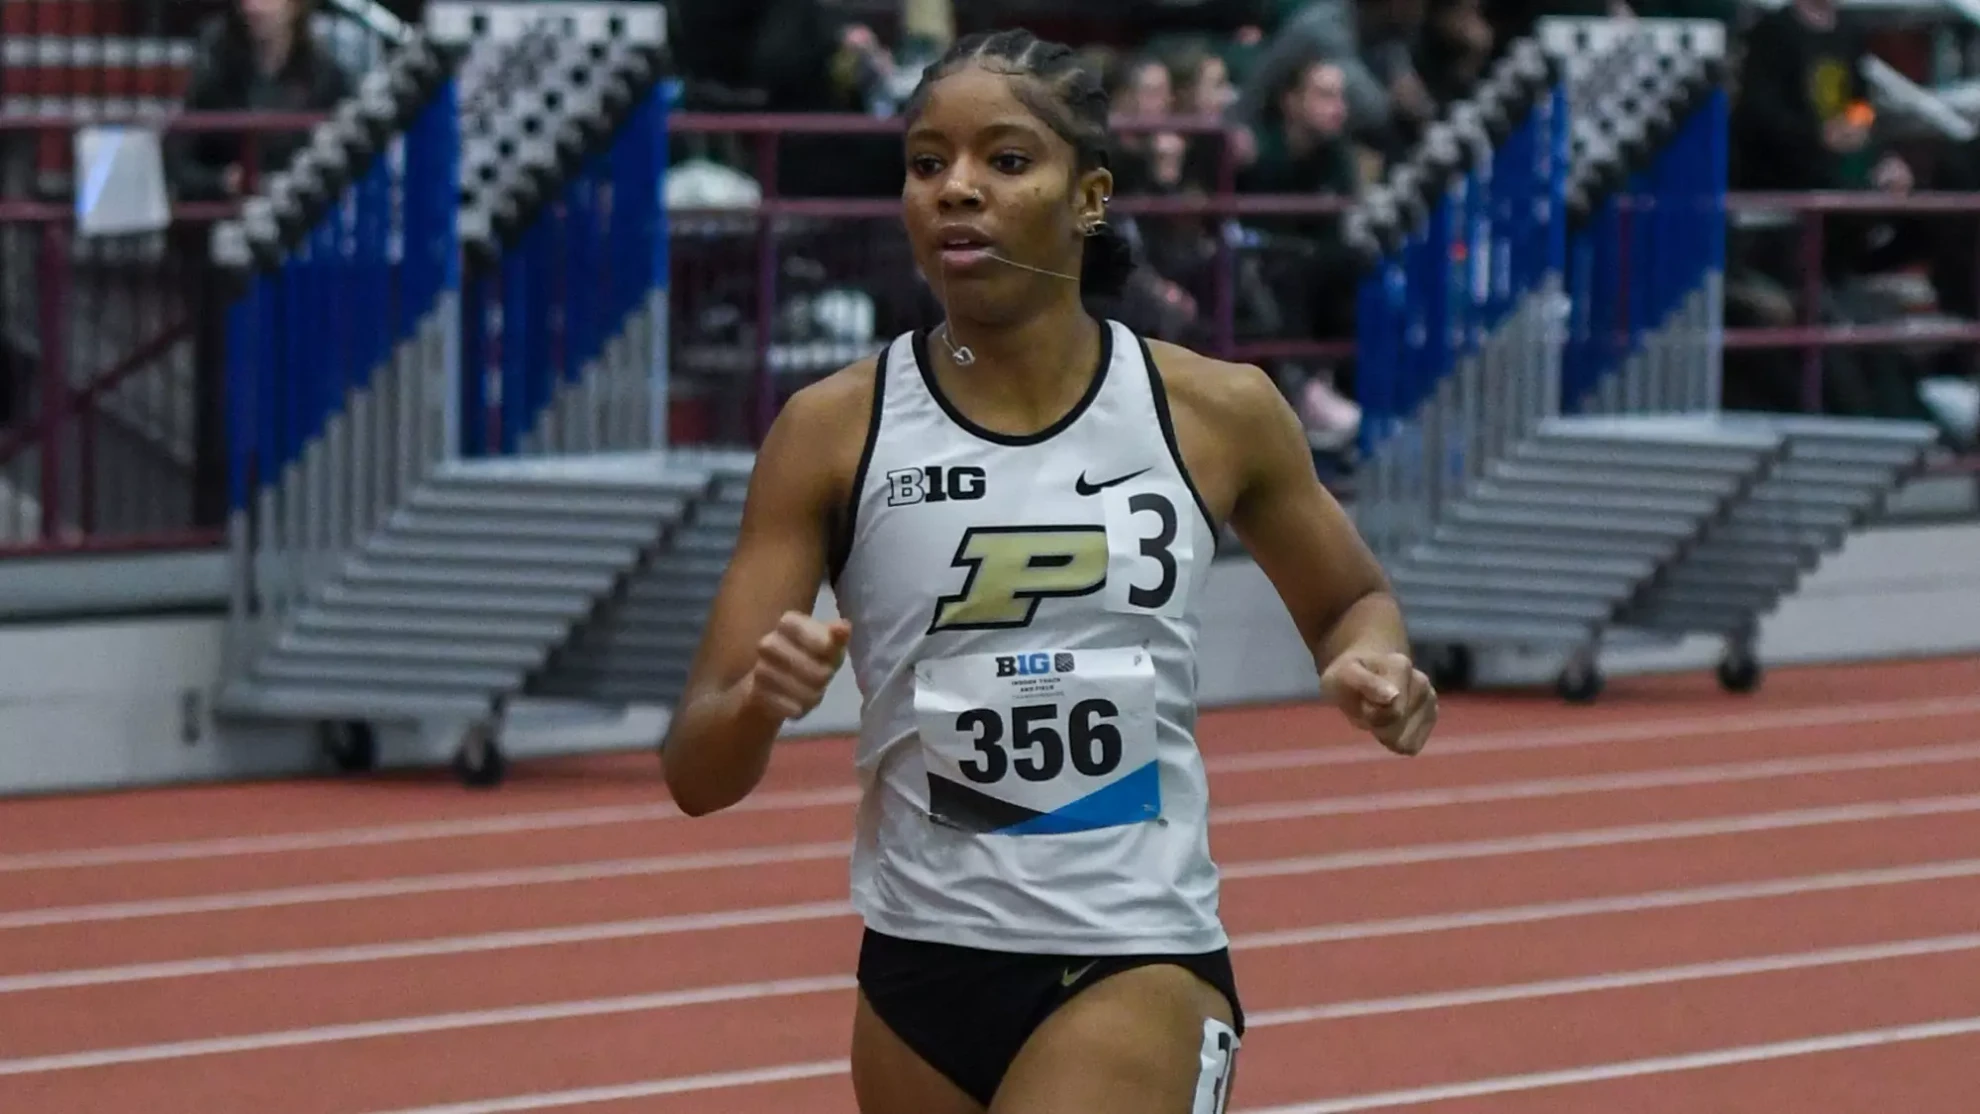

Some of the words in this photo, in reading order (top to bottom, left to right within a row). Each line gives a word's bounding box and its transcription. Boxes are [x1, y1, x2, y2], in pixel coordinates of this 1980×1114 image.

[926, 525, 1109, 635] P
[1128, 493, 1178, 609] 3
[955, 698, 1122, 784] 356
